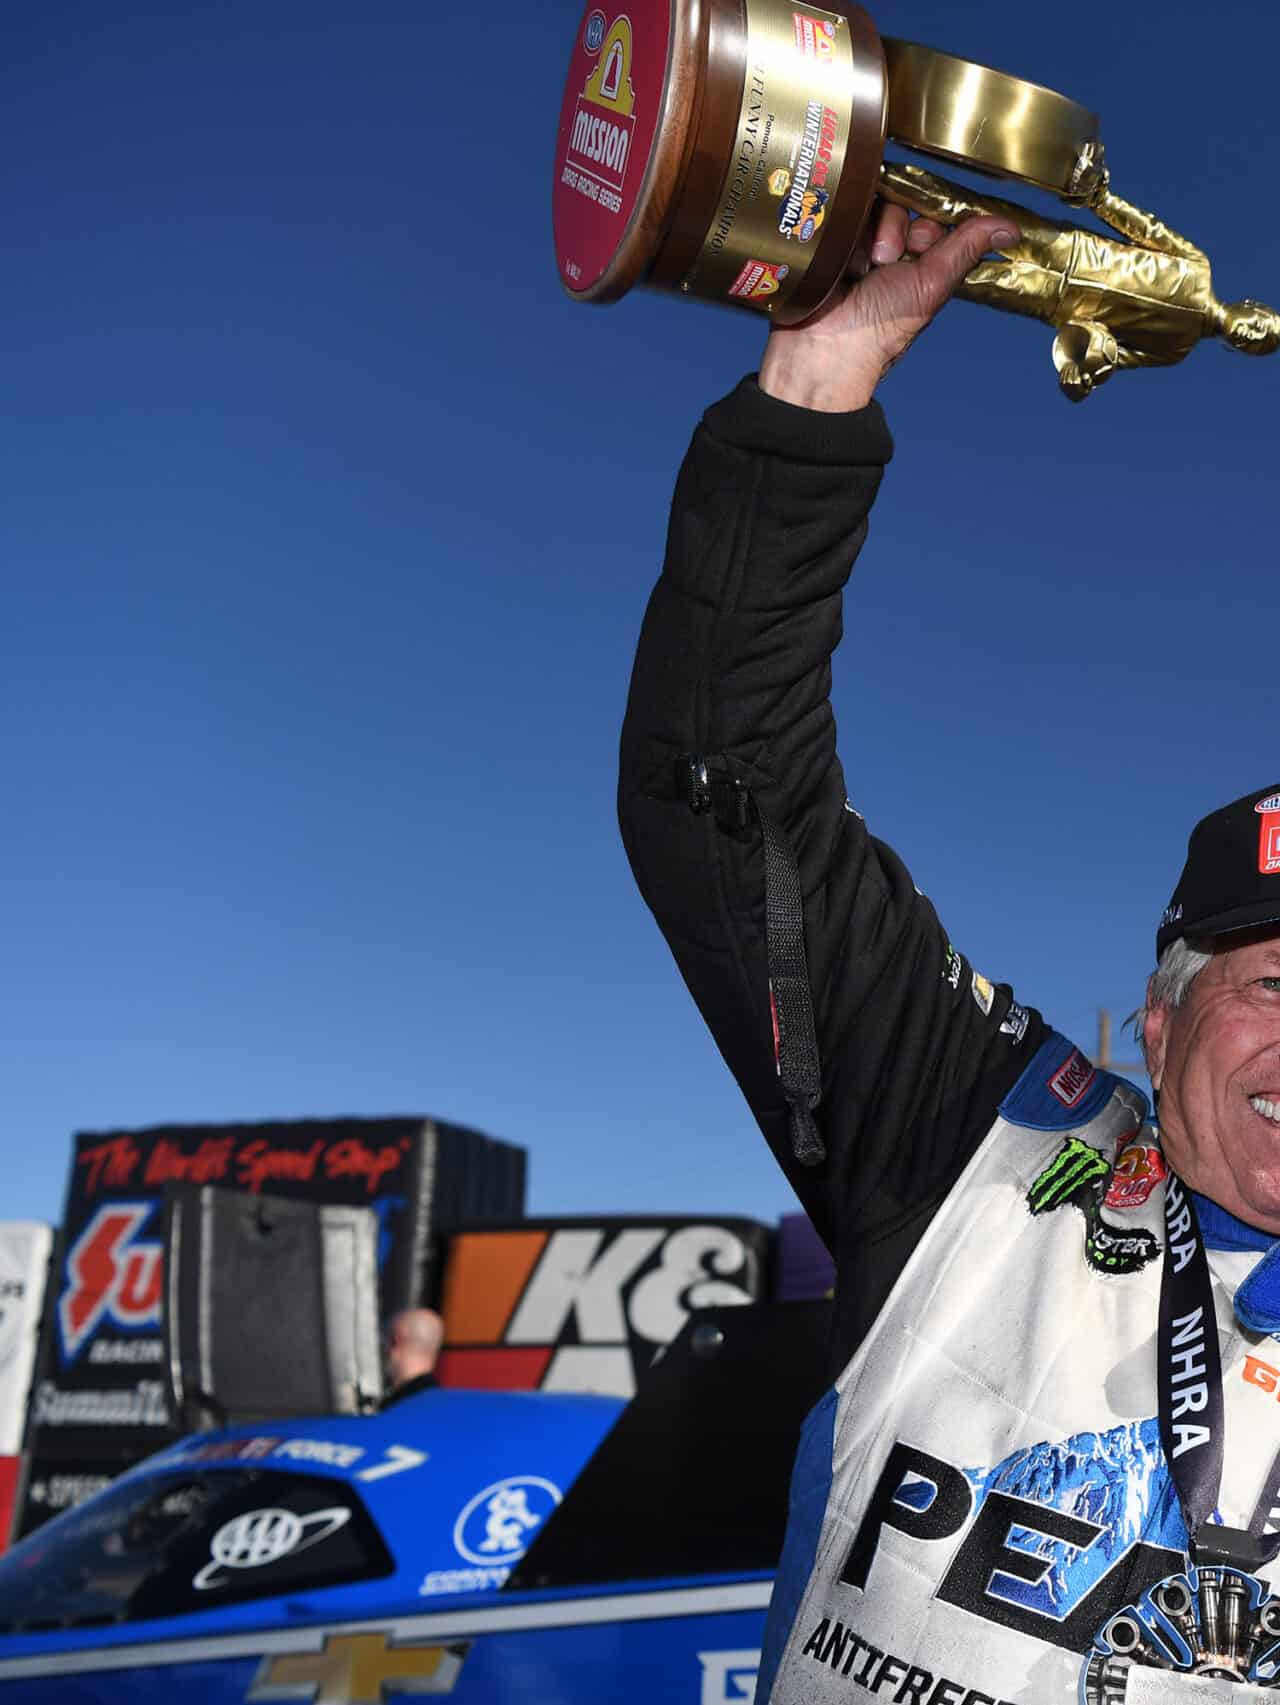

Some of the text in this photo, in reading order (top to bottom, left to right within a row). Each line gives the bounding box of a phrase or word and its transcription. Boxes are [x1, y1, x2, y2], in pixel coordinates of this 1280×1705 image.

[745, 76, 764, 140] FUNNY
[571, 110, 629, 174] MISSION
[737, 139, 753, 177] CAR
[779, 99, 823, 237] WINTERNATIONALS
[1171, 1306, 1211, 1460] NHRA
[354, 1443, 429, 1482] 7
